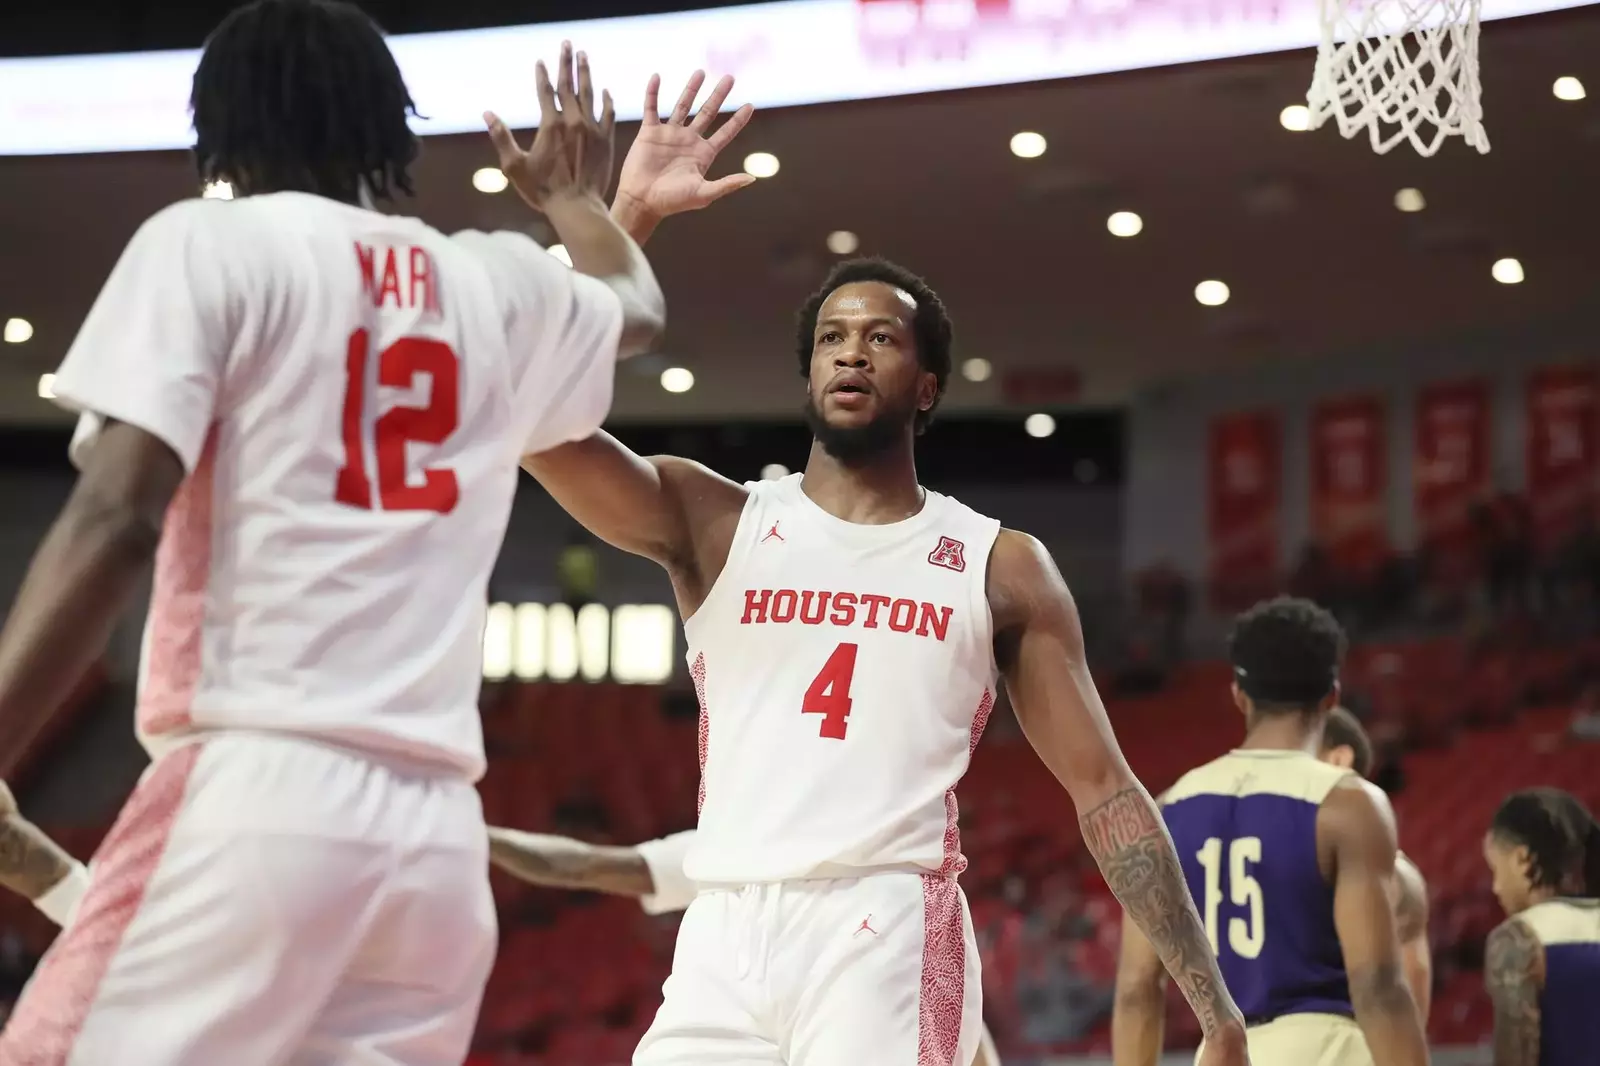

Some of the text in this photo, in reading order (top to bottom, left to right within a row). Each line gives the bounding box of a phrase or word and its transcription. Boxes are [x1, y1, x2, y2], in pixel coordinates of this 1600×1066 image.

[334, 327, 460, 516] 12
[740, 589, 953, 641] HOUSTON
[801, 642, 858, 740] 4
[1196, 836, 1265, 959] 15
